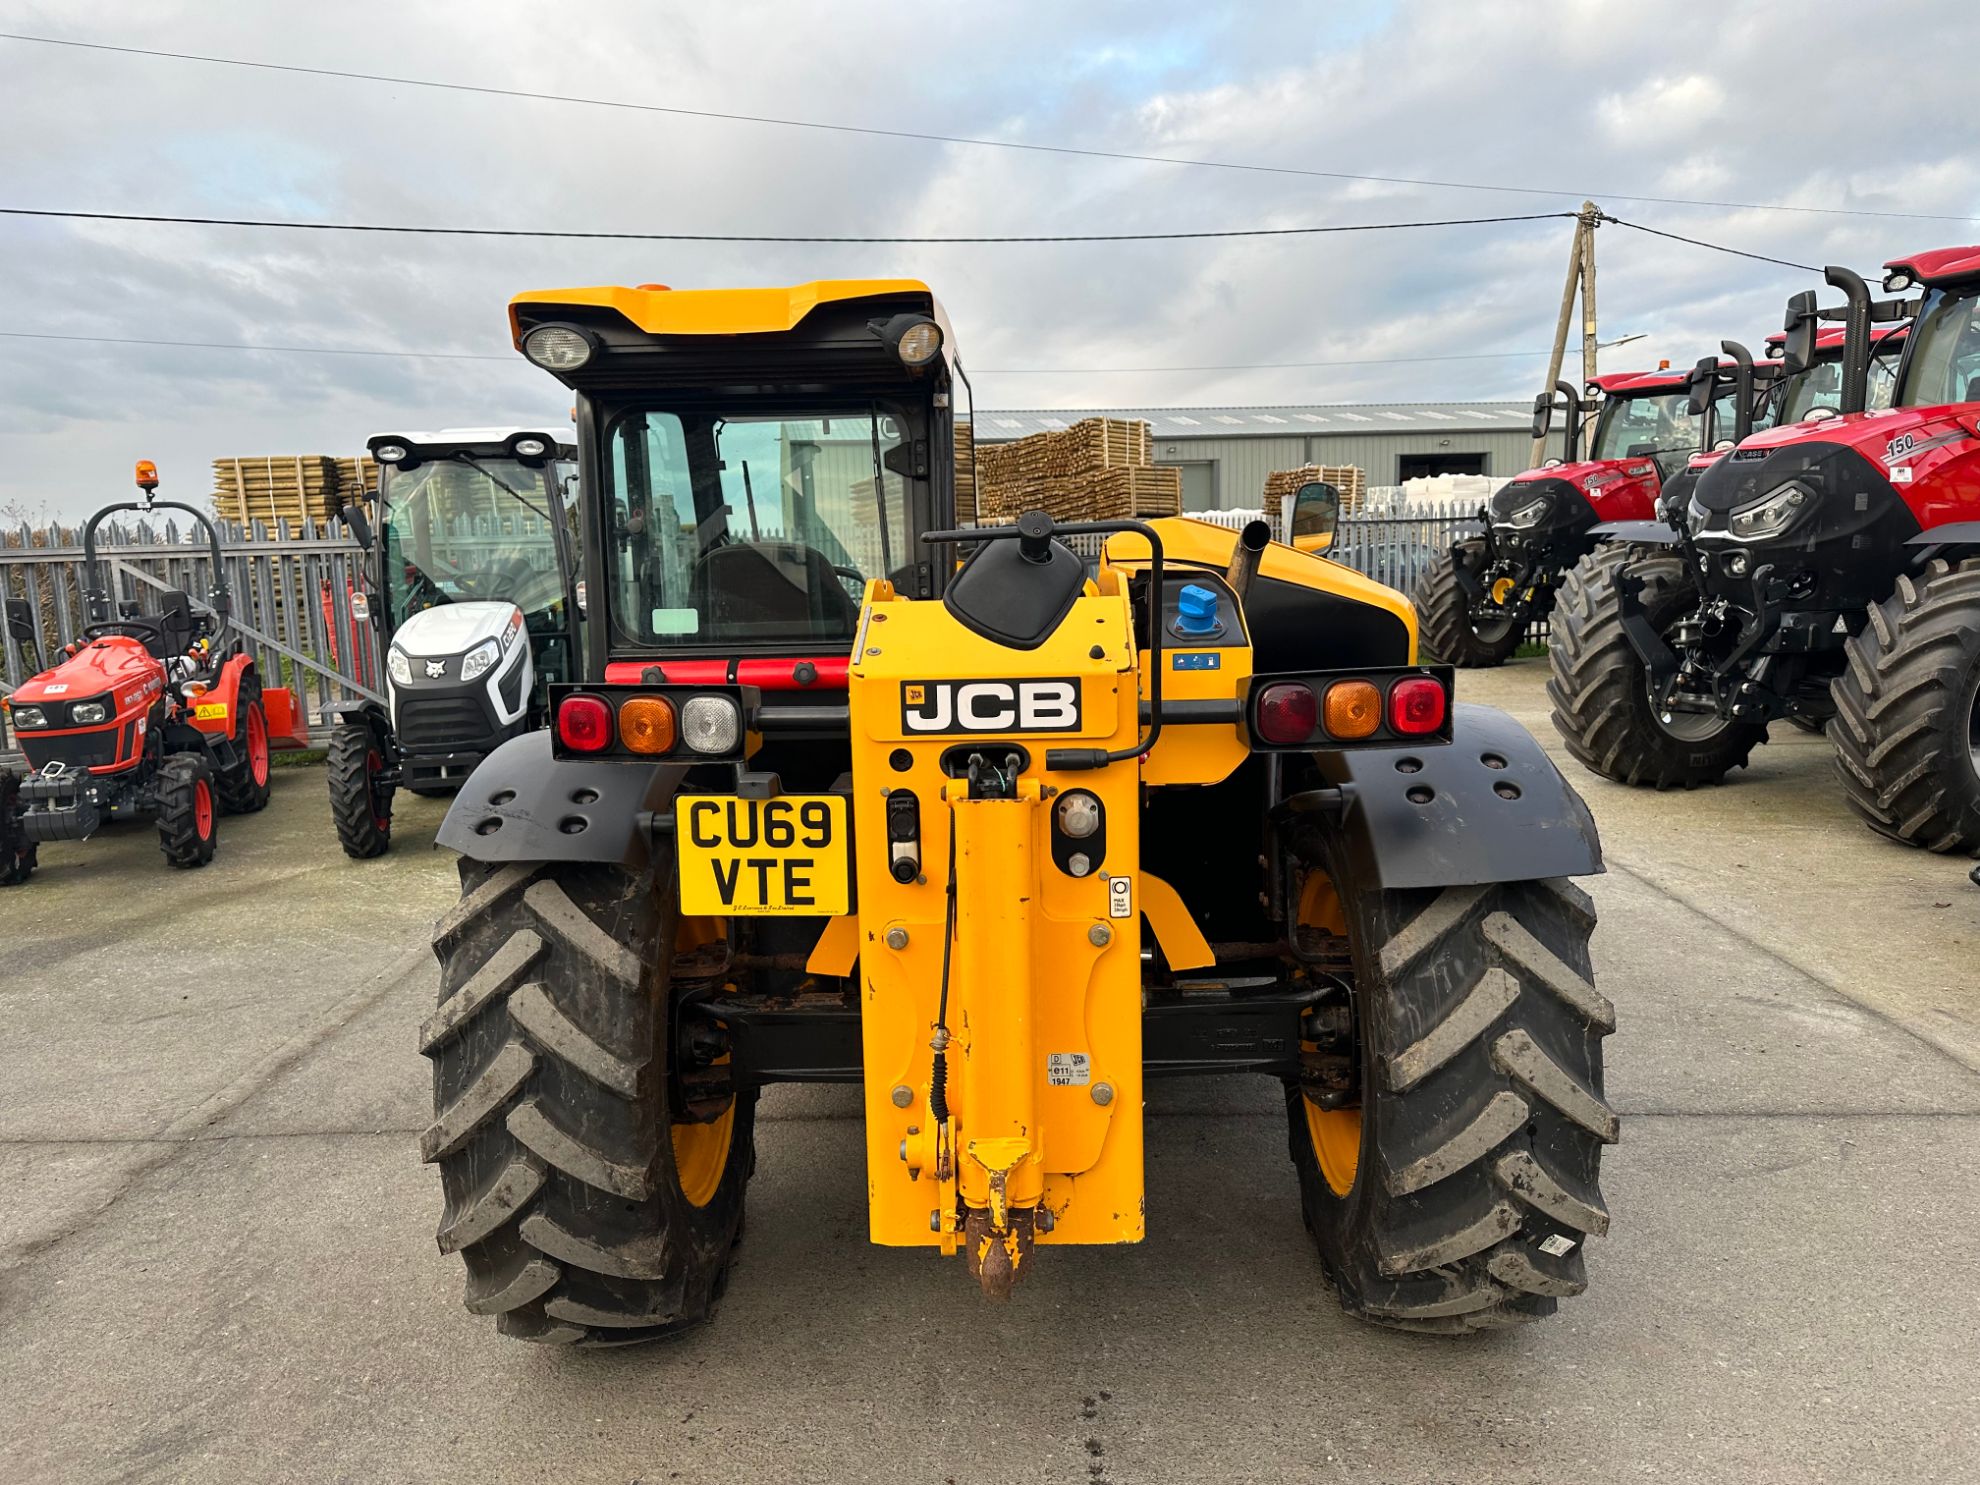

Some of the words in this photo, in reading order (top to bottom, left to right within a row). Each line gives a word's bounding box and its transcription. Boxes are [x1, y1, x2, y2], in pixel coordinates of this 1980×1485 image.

[1887, 432, 1914, 457] 150
[1584, 474, 1598, 486] 150
[906, 682, 1078, 731] JCB
[910, 689, 922, 700] JCB
[690, 800, 832, 848] CU69
[711, 858, 816, 905] VTE
